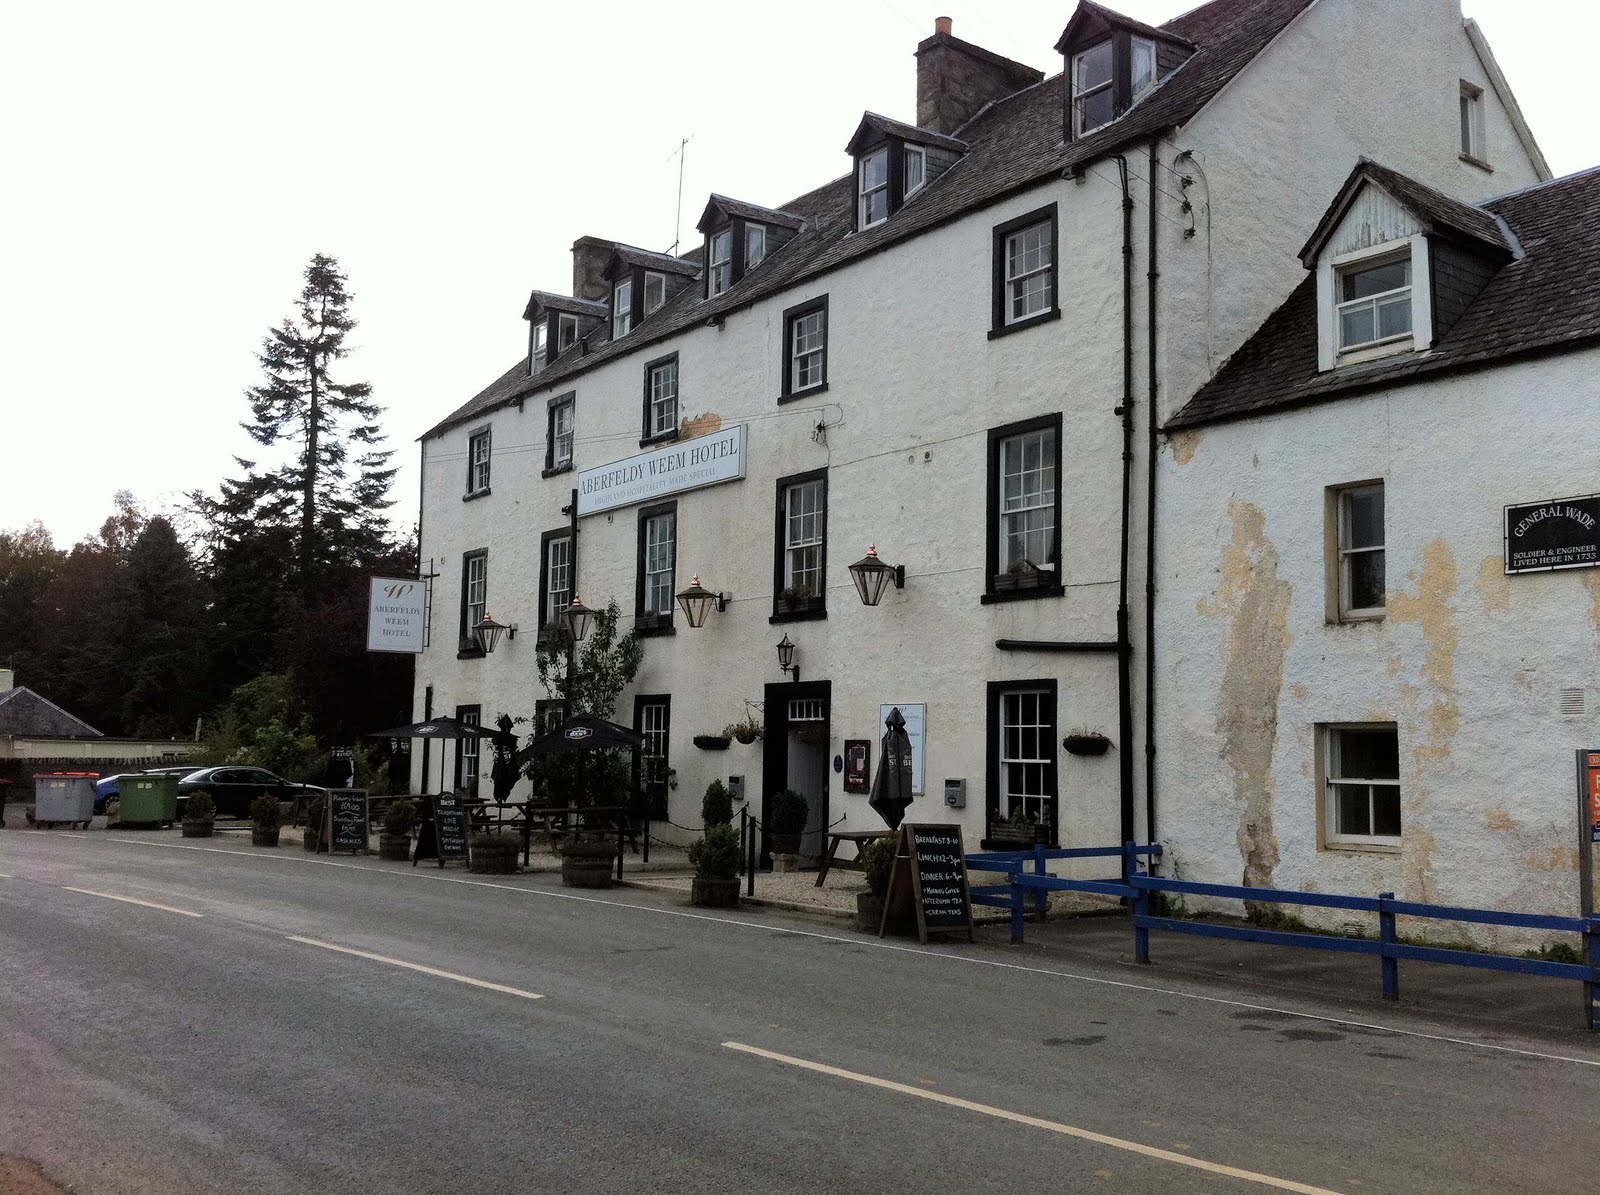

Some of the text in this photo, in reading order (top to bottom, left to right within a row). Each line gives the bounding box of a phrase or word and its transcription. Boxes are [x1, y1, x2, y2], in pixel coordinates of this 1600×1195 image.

[580, 438, 738, 496] ABERFELDY WEEM HOTEL
[595, 467, 717, 505] HIGHLAND HOSPITALITY MADE SPECIAL
[1514, 505, 1596, 537] GENERAL WADE
[1514, 550, 1546, 560] SOLDIER
[1557, 545, 1597, 555] ENGINEER
[1514, 558, 1538, 567] LIVED
[1540, 555, 1562, 564] HERE
[1564, 554, 1574, 562] IN
[375, 605, 421, 616] ABERFELDY
[385, 617, 410, 626] WEEM
[382, 628, 411, 638] HOTEL
[915, 834, 945, 845] BREAKFAST
[917, 851, 939, 862] LUNCH
[920, 871, 943, 881] DINNER
